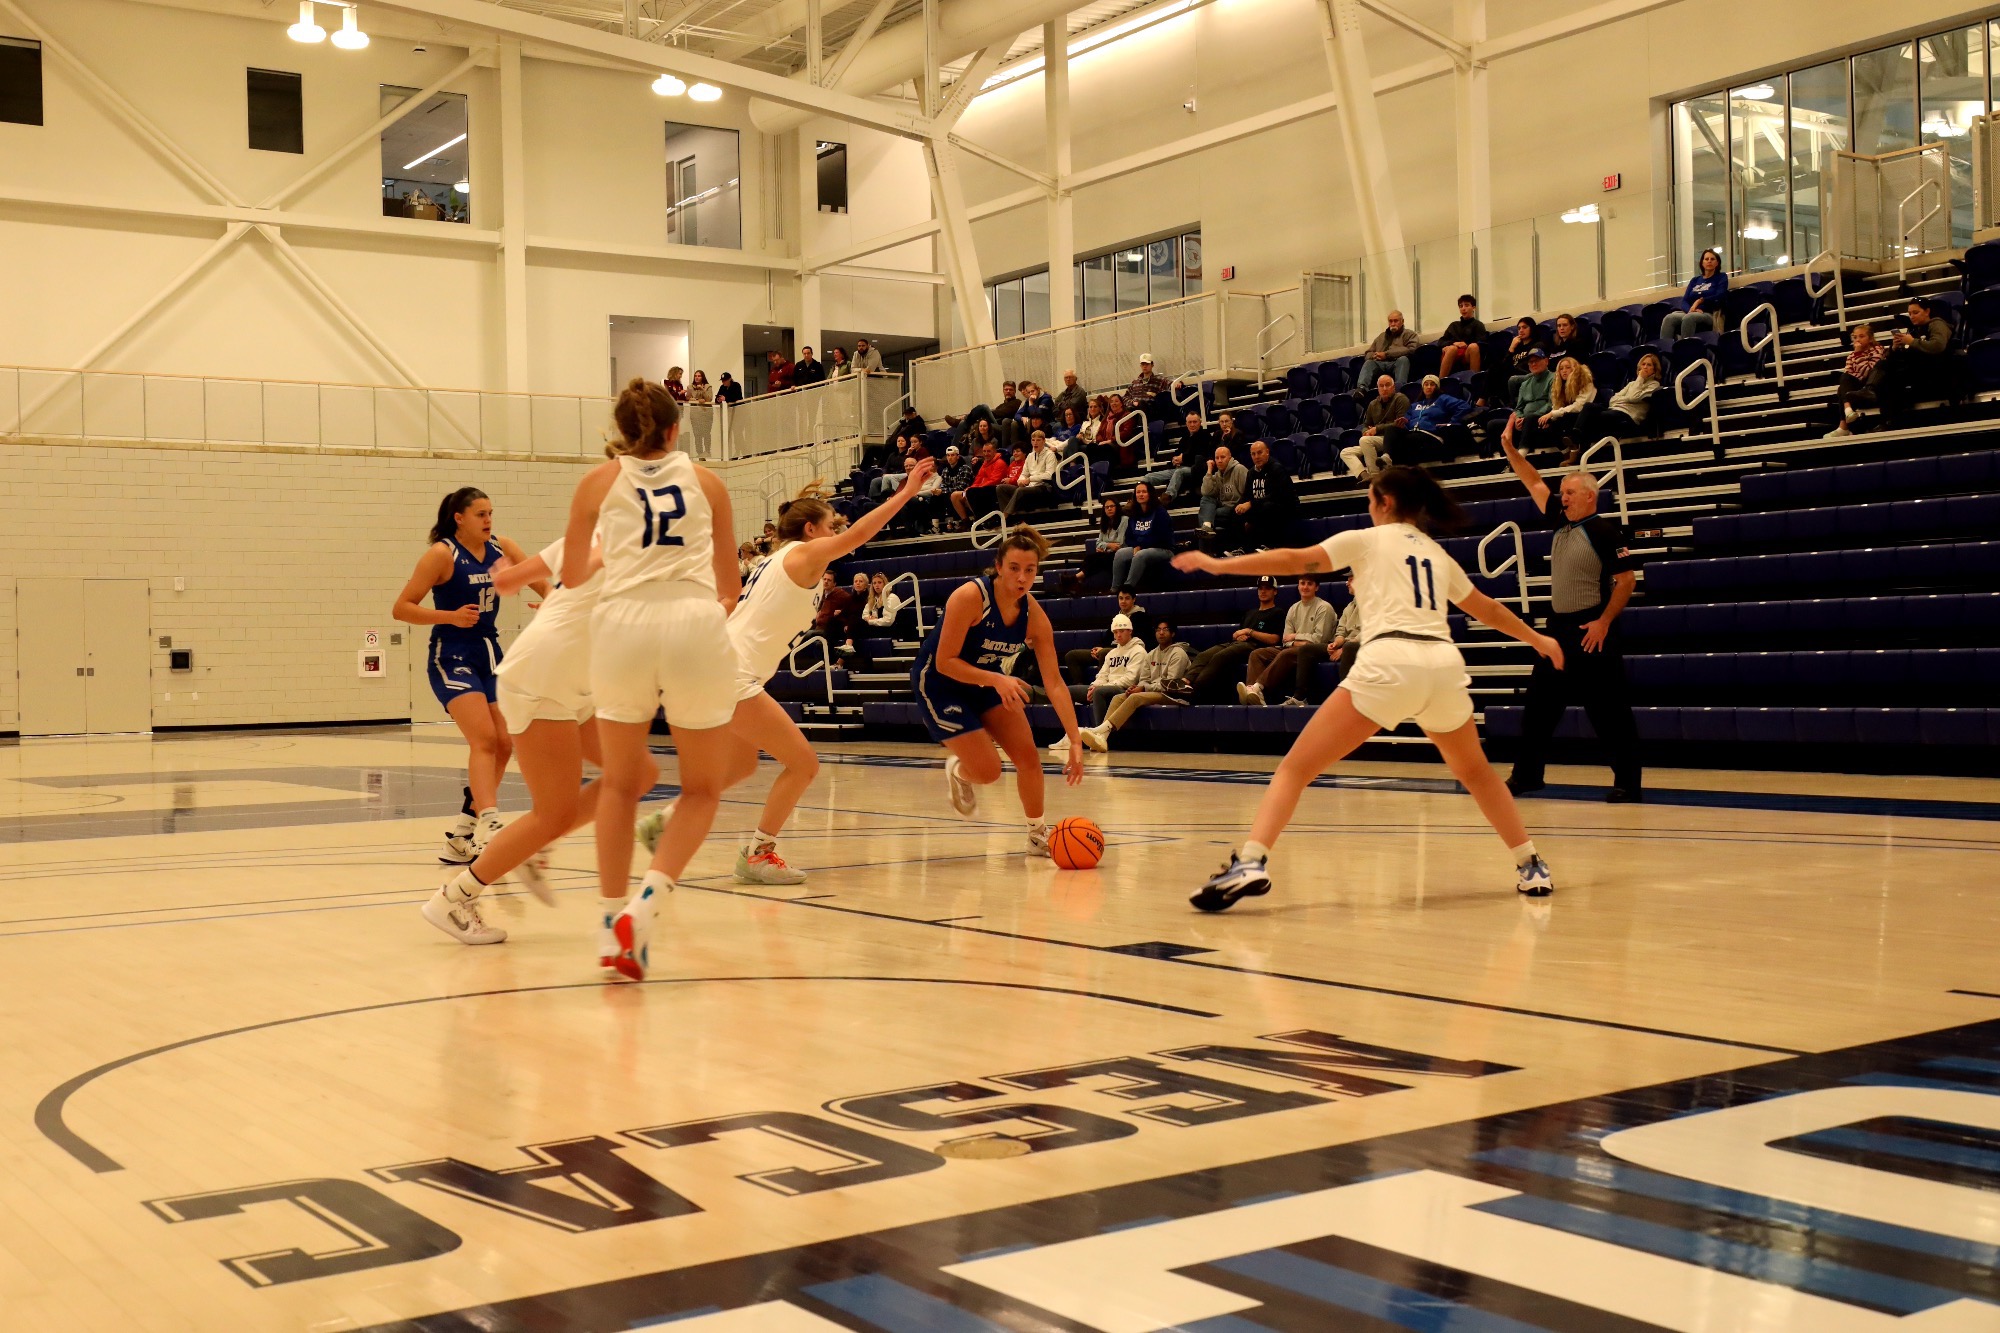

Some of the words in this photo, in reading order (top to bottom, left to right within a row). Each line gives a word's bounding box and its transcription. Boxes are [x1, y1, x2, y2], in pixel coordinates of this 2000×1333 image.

[1604, 175, 1616, 188] EXIT
[1222, 267, 1231, 279] EXIT
[636, 484, 687, 549] 12
[467, 572, 492, 585] MUL
[1405, 555, 1437, 611] 11
[478, 587, 496, 613] 12
[140, 1029, 1525, 1289] NESCAC
